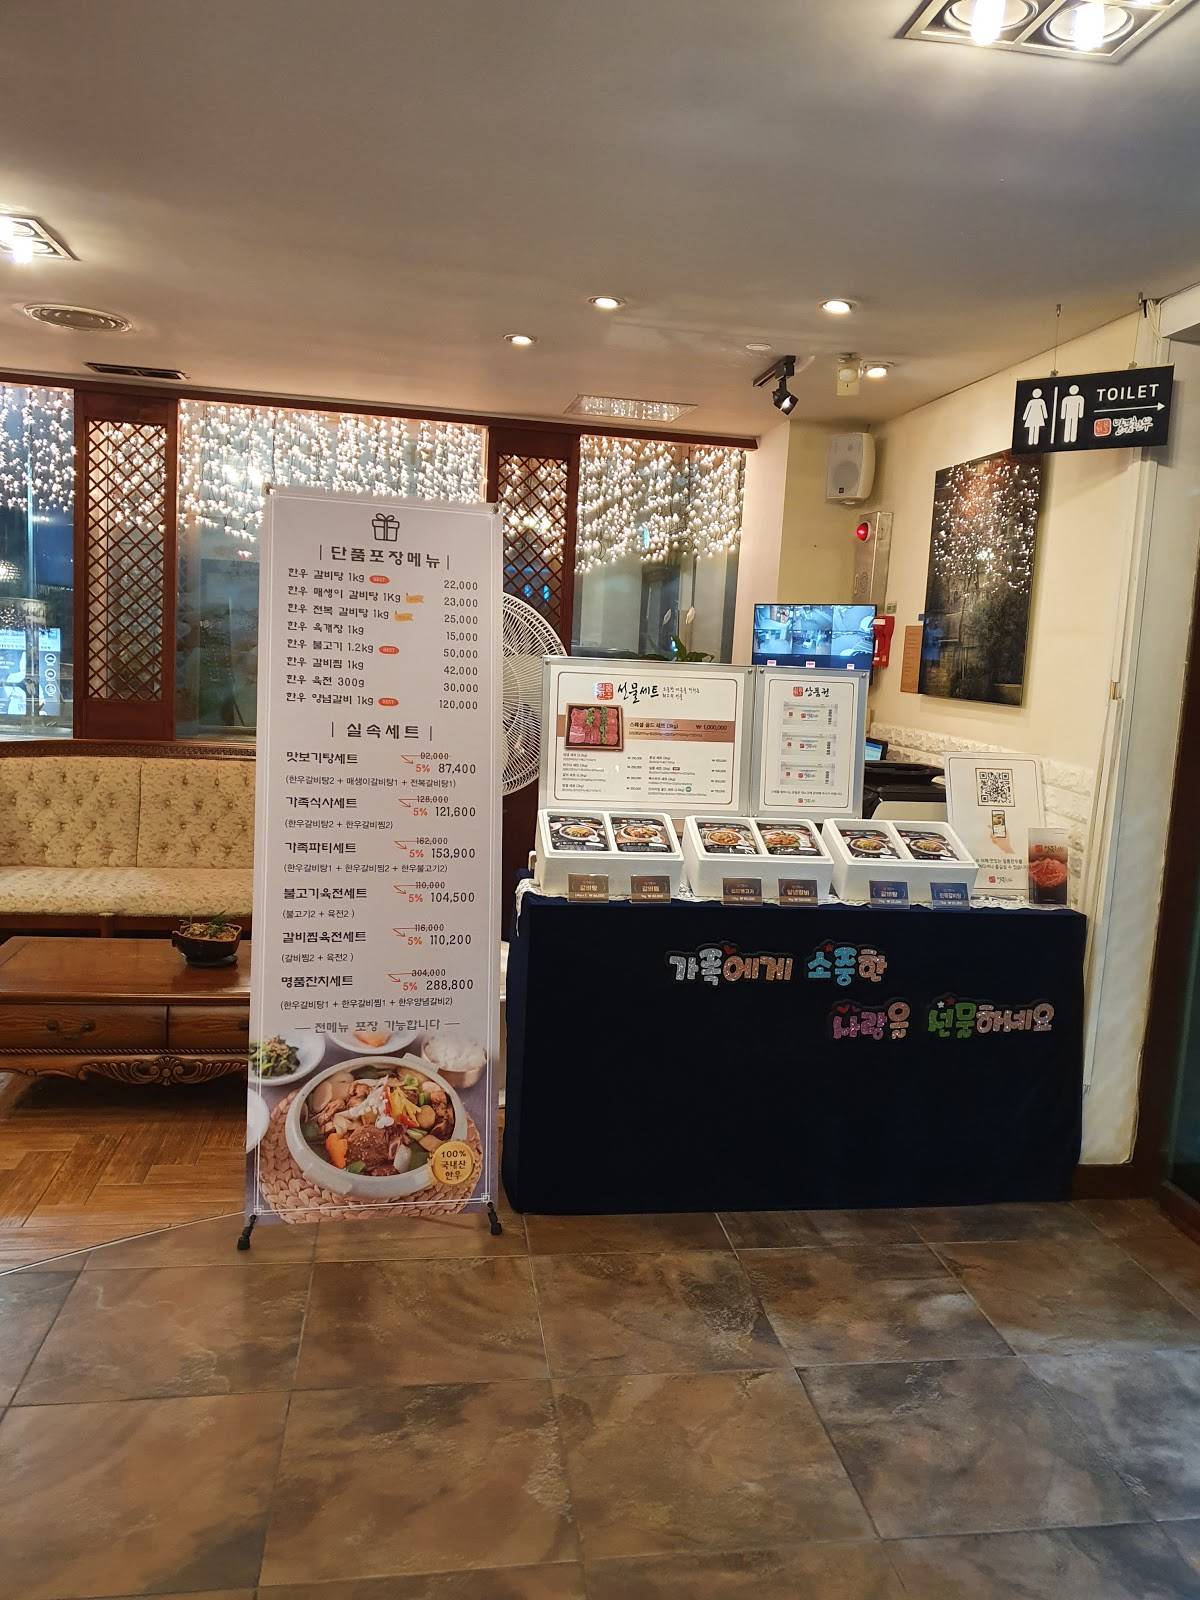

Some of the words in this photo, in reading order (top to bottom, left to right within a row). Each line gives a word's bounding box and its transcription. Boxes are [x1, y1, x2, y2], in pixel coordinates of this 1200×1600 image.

[1096, 384, 1159, 402] TOILET
[331, 546, 440, 569] 단품포장메뉴
[288, 568, 308, 578] 한우
[314, 569, 344, 581] 갈비탕
[349, 573, 365, 583] 1kg
[444, 580, 478, 591] 22,000
[288, 586, 307, 596] 한우
[314, 587, 343, 600] 매생이
[349, 589, 378, 602] 갈비탕
[383, 592, 401, 603] 1Kg
[444, 597, 478, 608] 23,000
[287, 604, 307, 614] 한우
[313, 604, 333, 616] 전복
[339, 606, 368, 619] 갈비탕
[373, 610, 389, 620] 1kg
[444, 615, 478, 625] 25,000
[287, 621, 307, 632] 한우
[313, 623, 343, 635] 육개장
[349, 625, 364, 635] 1kg
[446, 632, 478, 642] 15,000
[287, 639, 307, 650] 한우
[313, 640, 343, 652] 불고기
[348, 642, 374, 654] 1.2kg
[443, 649, 478, 659] 50,000
[287, 657, 307, 667] 한우
[313, 658, 343, 670] 갈비찜
[348, 660, 364, 671] 1kg
[444, 666, 478, 676] 42,000
[286, 675, 306, 685] 한우
[312, 675, 332, 687] 육전
[338, 677, 365, 688] 300g
[443, 683, 478, 693] 30,000
[618, 682, 659, 704] 선물세트
[805, 687, 829, 697] 상품권
[286, 692, 306, 703] 한우
[312, 694, 352, 706] 양념갈비
[357, 696, 374, 706] 1kg
[440, 699, 478, 710] 120,000
[347, 723, 420, 739] 실속세트
[287, 752, 358, 764] 맛보기탕세트
[416, 764, 431, 773] 5%
[438, 764, 476, 774] 87,400
[286, 797, 357, 809] 가족식사세트
[413, 808, 428, 817] 5%
[435, 807, 476, 817] 121,600
[285, 842, 356, 854] 가족파티세트
[409, 850, 424, 858] 5%
[432, 848, 476, 859] 153,900
[283, 888, 368, 900] 불고기육전세트
[409, 894, 423, 903] 5%
[431, 892, 475, 903] 104,500
[283, 931, 367, 943] 갈비찜육전세트
[408, 937, 422, 945] 5%
[430, 935, 472, 945] 110,200
[668, 946, 795, 987] 가족에게
[807, 945, 888, 987] 소중한
[282, 975, 353, 988] 명품잔치세트
[403, 982, 418, 991] 5%
[426, 979, 474, 991] 288,800
[315, 1022, 349, 1034] 전메뉴
[356, 1021, 378, 1032] 포장
[384, 1019, 441, 1031] 가능합니다
[831, 1000, 912, 1041] 사랑을
[927, 1001, 1055, 1039] 선물하세요
[442, 1160, 465, 1170] 국내산
